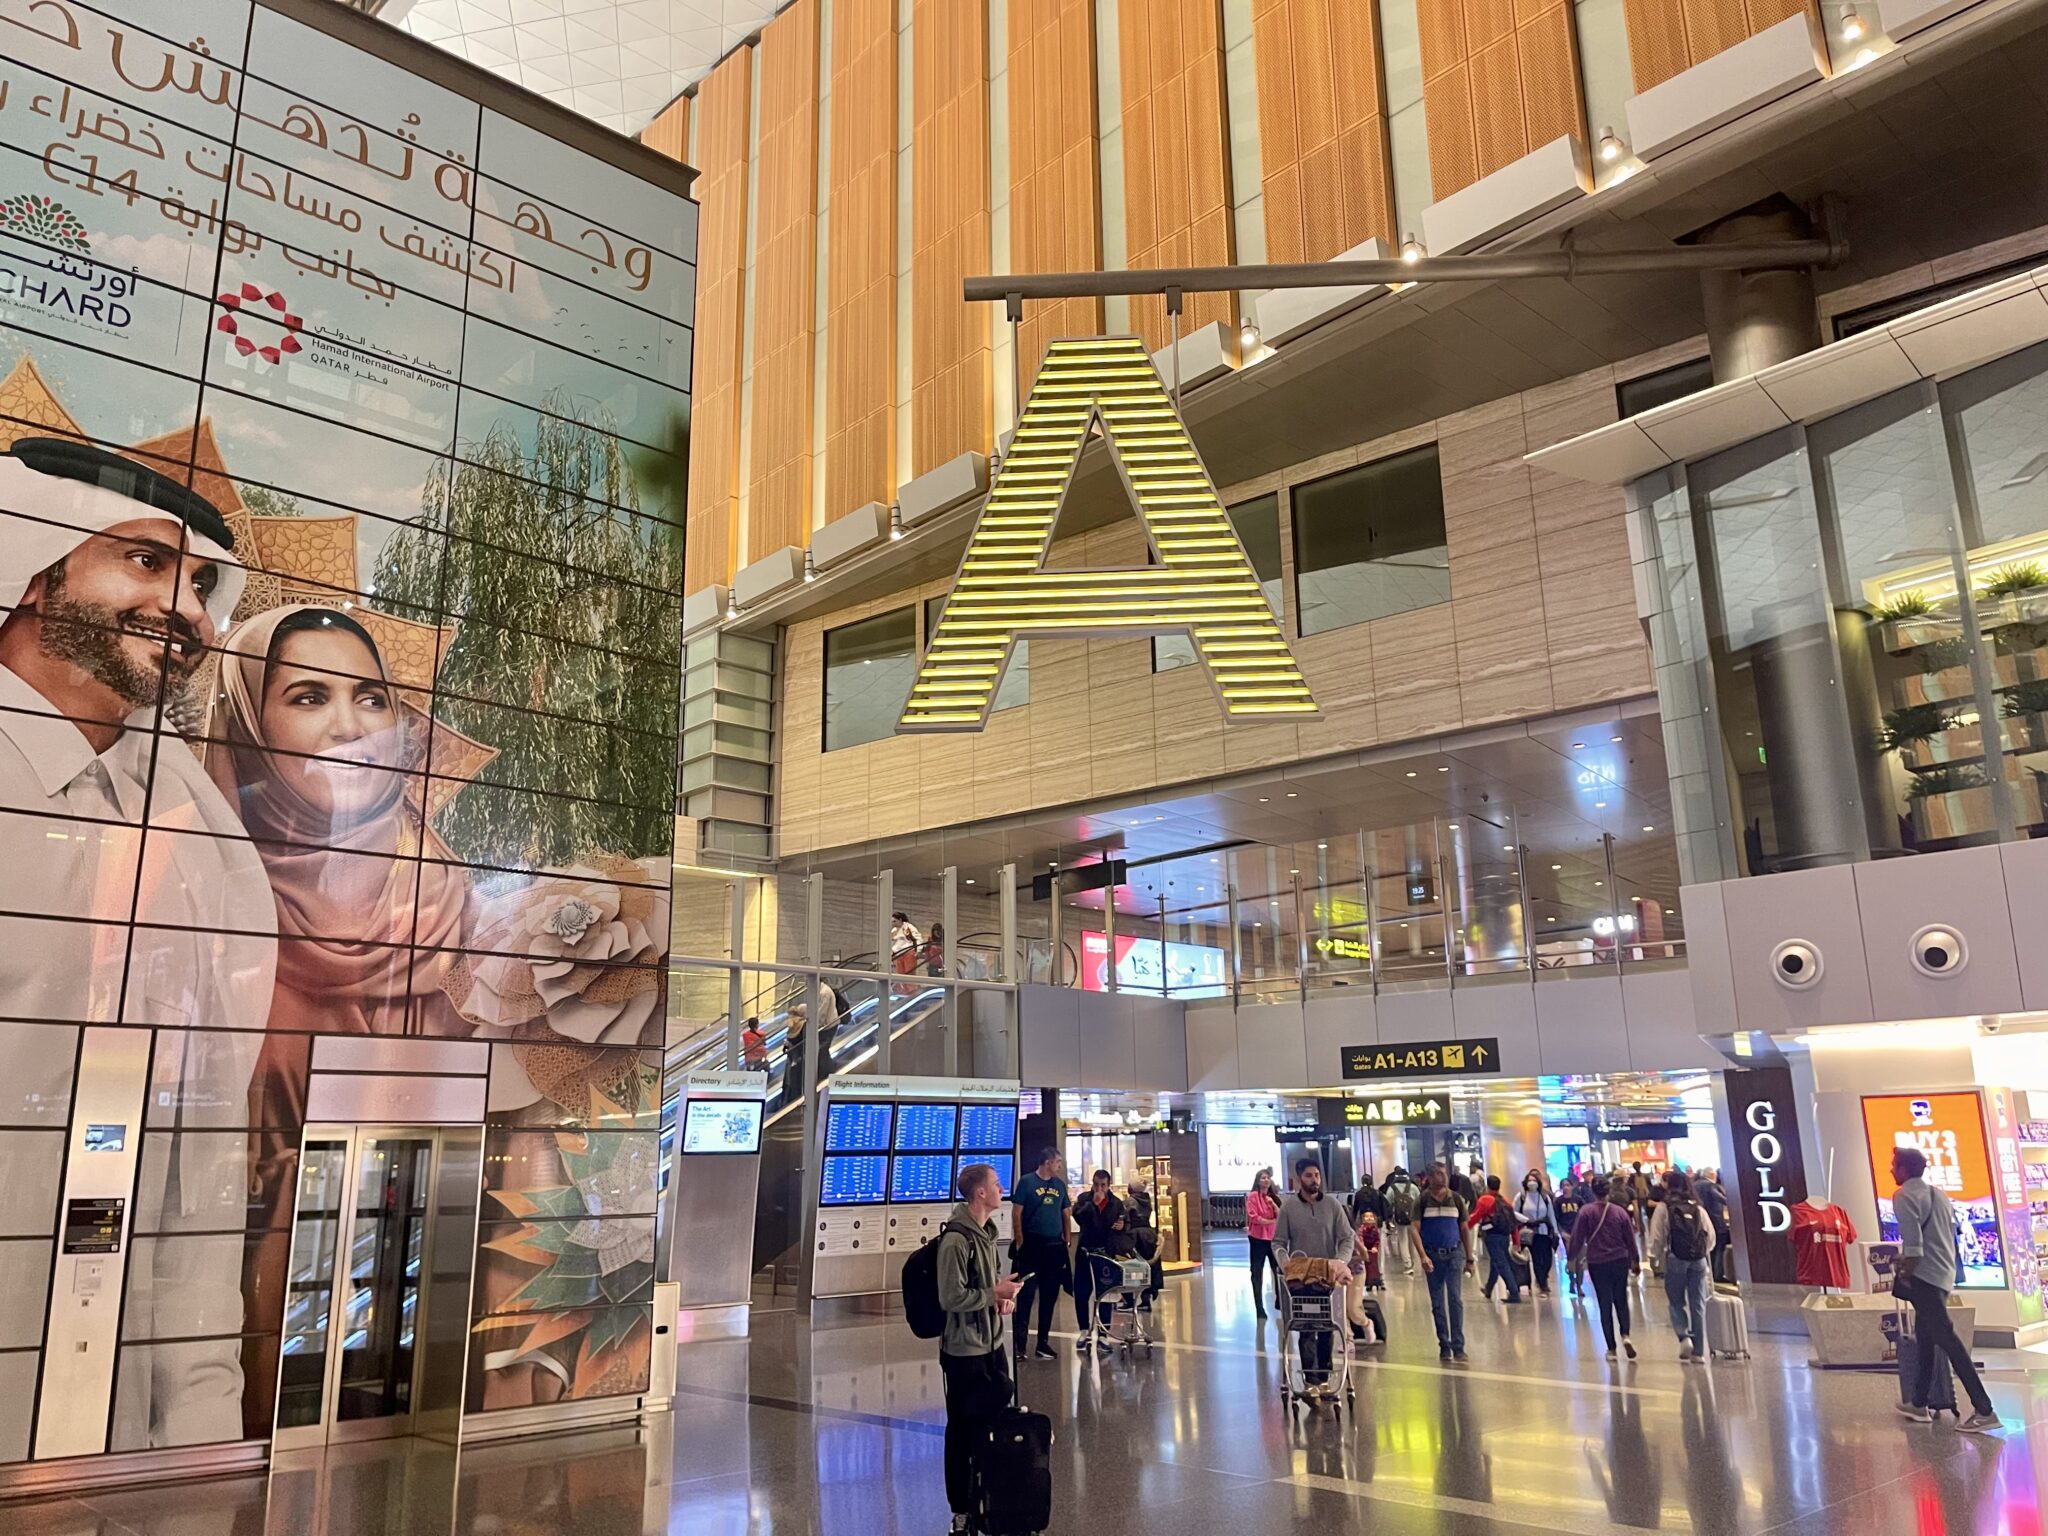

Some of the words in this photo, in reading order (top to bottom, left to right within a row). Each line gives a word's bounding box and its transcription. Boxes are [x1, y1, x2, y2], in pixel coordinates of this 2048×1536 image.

[29, 86, 165, 160] خضراء
[43, 142, 140, 206] C14
[185, 146, 362, 233] مساحات
[160, 186, 263, 259] بوابة
[379, 224, 516, 293] اكتشف
[282, 243, 397, 307] بجانب
[314, 325, 366, 346] الدولي
[370, 343, 408, 361] حمد
[310, 353, 350, 373] QATAR
[311, 338, 349, 358] Hamad
[351, 350, 415, 380] International
[416, 371, 450, 391] Airport
[412, 356, 452, 376] مطار
[354, 369, 388, 385] قطر
[894, 335, 1326, 734] A
[1374, 1050, 1438, 1069] A1-A13
[690, 1077, 721, 1086] Directory
[834, 1080, 853, 1089] Flight
[853, 1081, 890, 1089] Information
[1365, 1102, 1381, 1120] A
[1894, 1130, 1940, 1149] BUY
[1941, 1129, 1957, 1149] 3
[1745, 1101, 1792, 1232] GOLD
[1561, 1202, 1579, 1213] GAP
